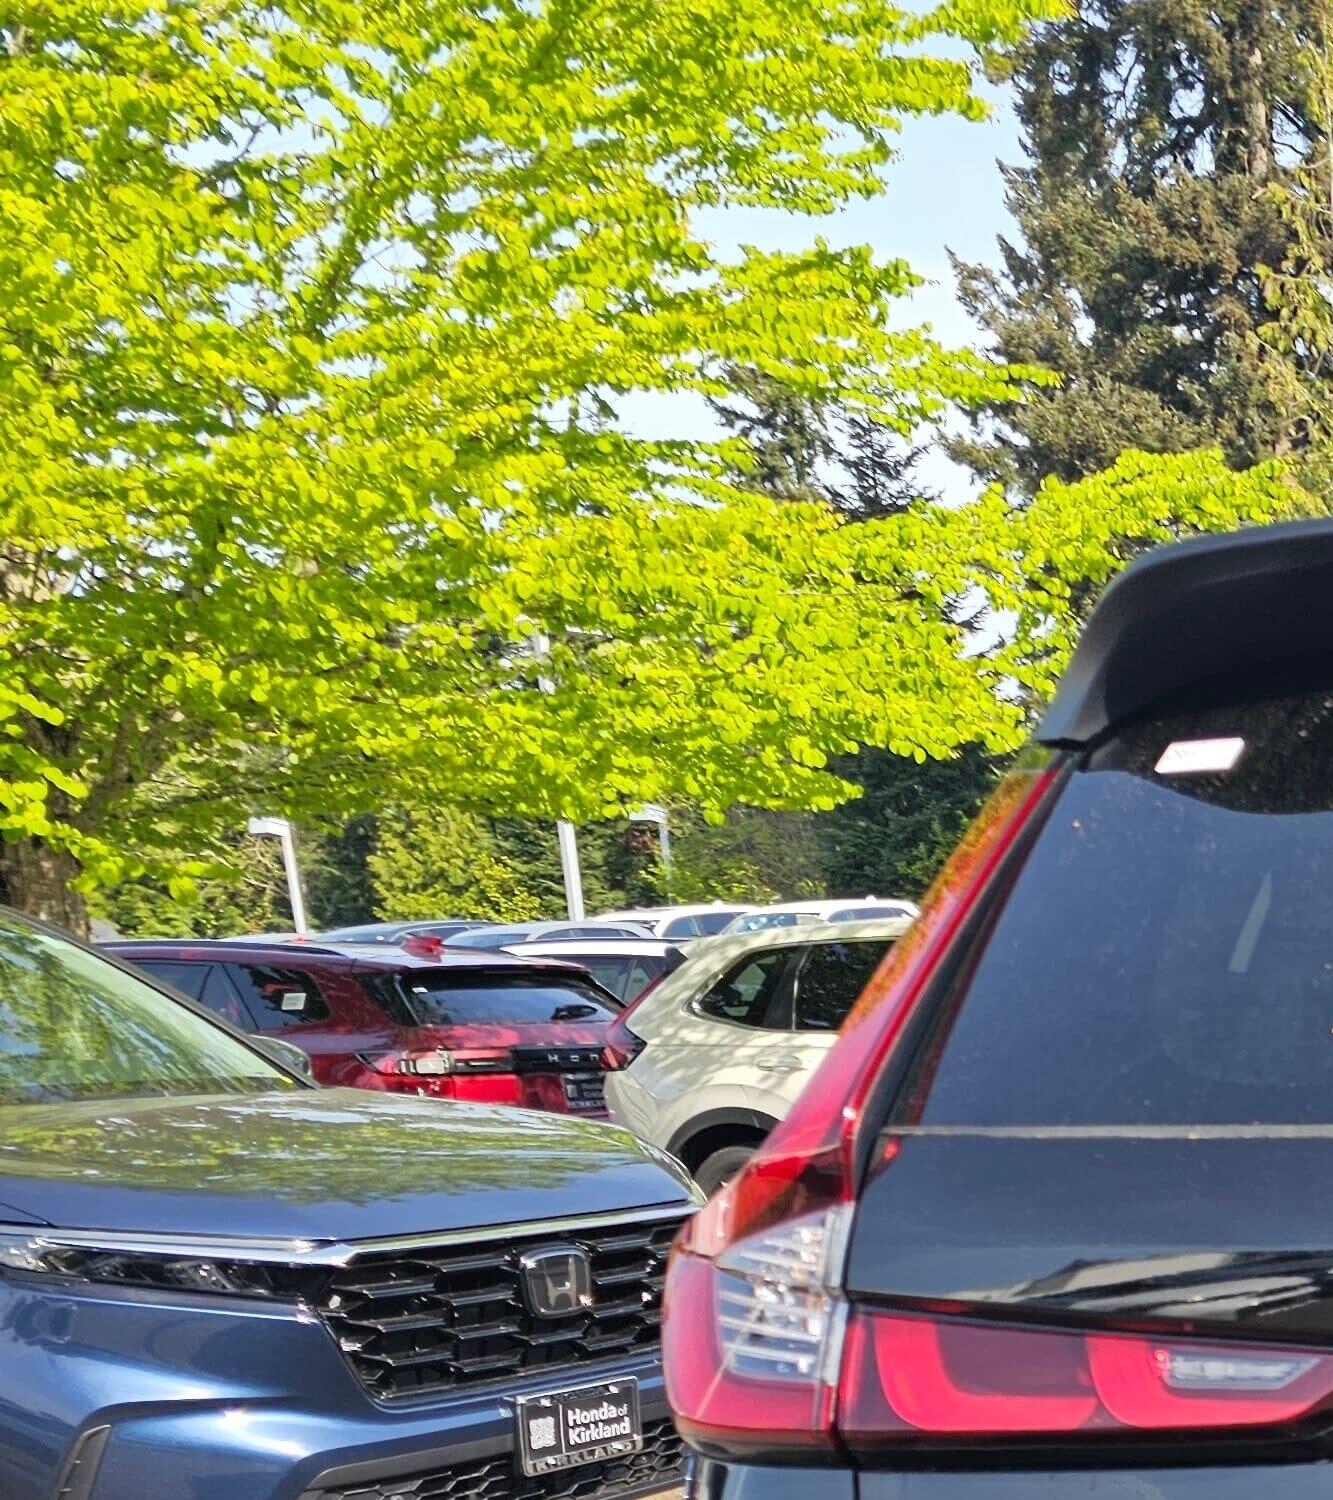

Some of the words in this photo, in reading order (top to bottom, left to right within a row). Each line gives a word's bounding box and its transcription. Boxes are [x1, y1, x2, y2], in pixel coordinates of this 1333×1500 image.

[547, 1053, 600, 1063] HON
[567, 1401, 618, 1427] Honda
[618, 1403, 629, 1417] of
[568, 1416, 631, 1446] Kirkland
[535, 1441, 632, 1472] KRKLAND
